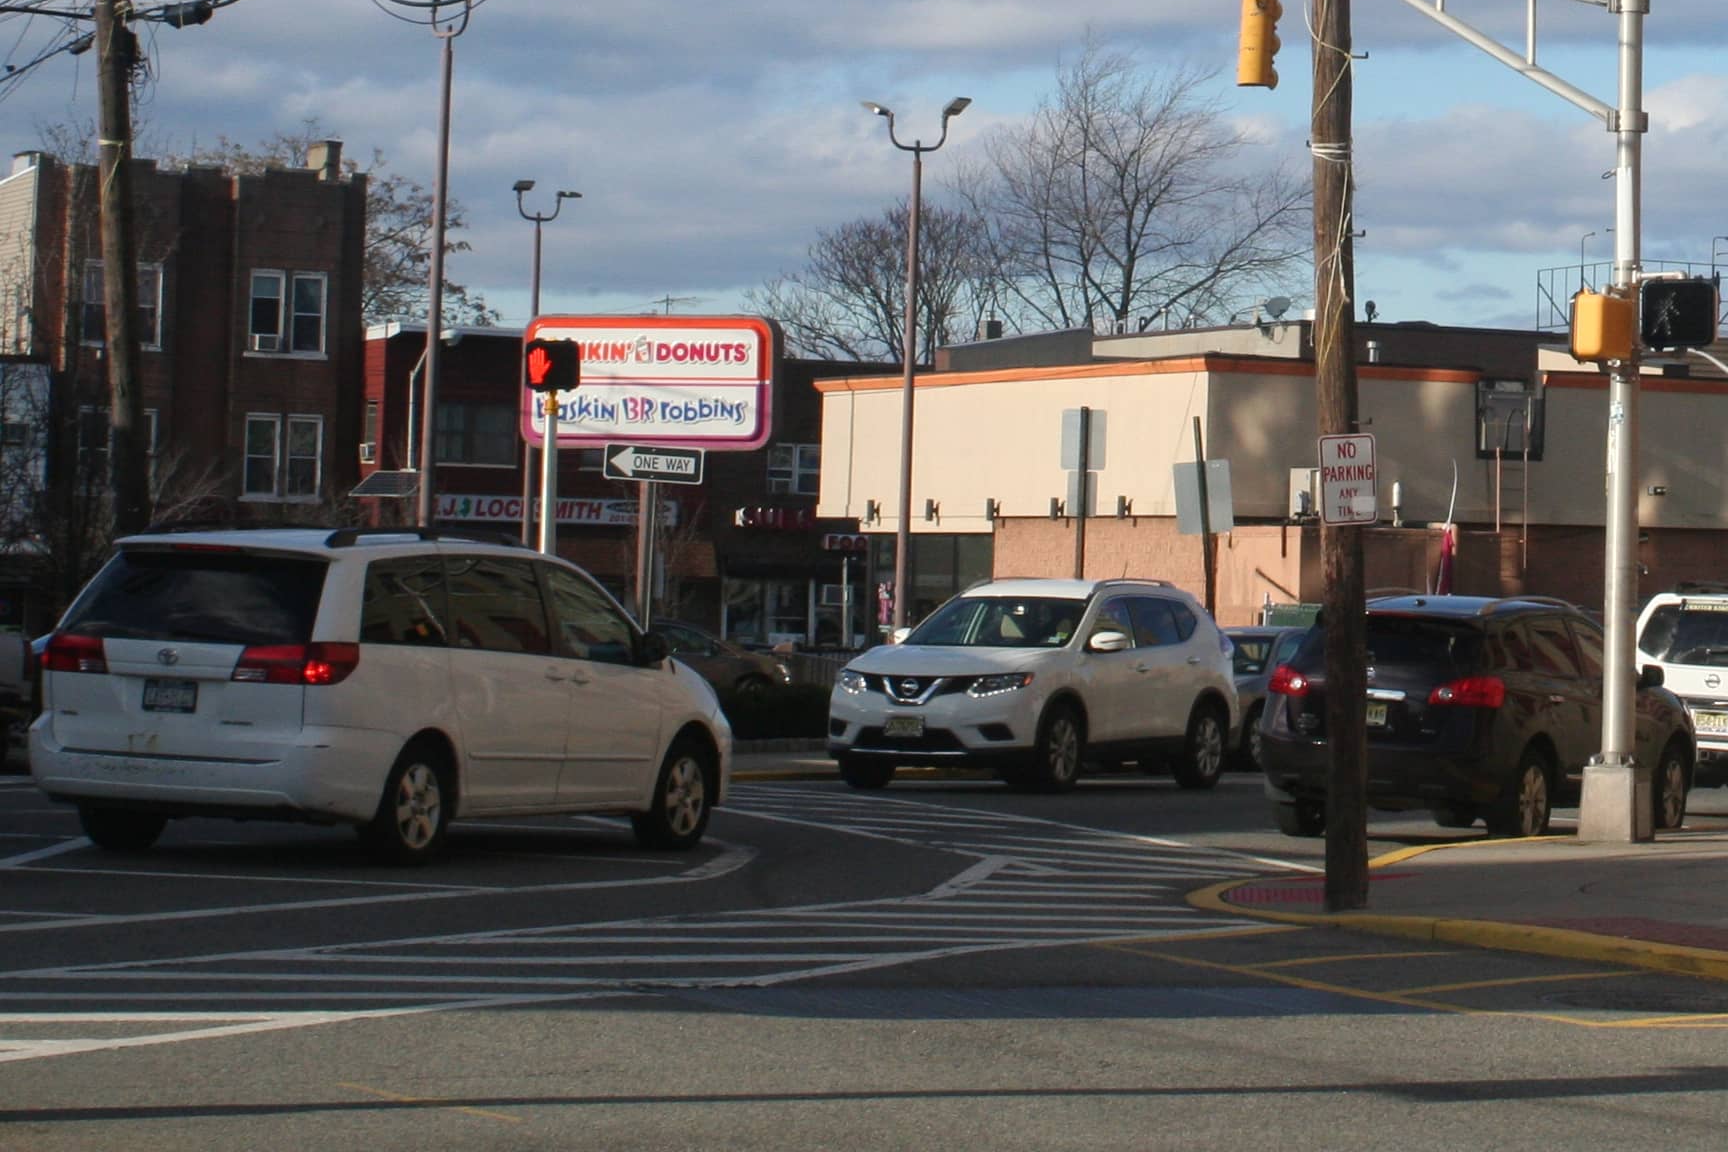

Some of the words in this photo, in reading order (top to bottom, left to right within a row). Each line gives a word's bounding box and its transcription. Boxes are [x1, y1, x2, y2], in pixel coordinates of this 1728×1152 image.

[655, 342, 748, 363] DONUTS
[622, 396, 655, 420] BR
[660, 397, 748, 423] robbins
[1337, 442, 1357, 459] NO
[633, 455, 660, 470] ONE
[665, 458, 691, 473] WAY
[1323, 464, 1374, 483] PARKING
[1338, 488, 1358, 499] ANY
[1338, 505, 1362, 517] TIM
